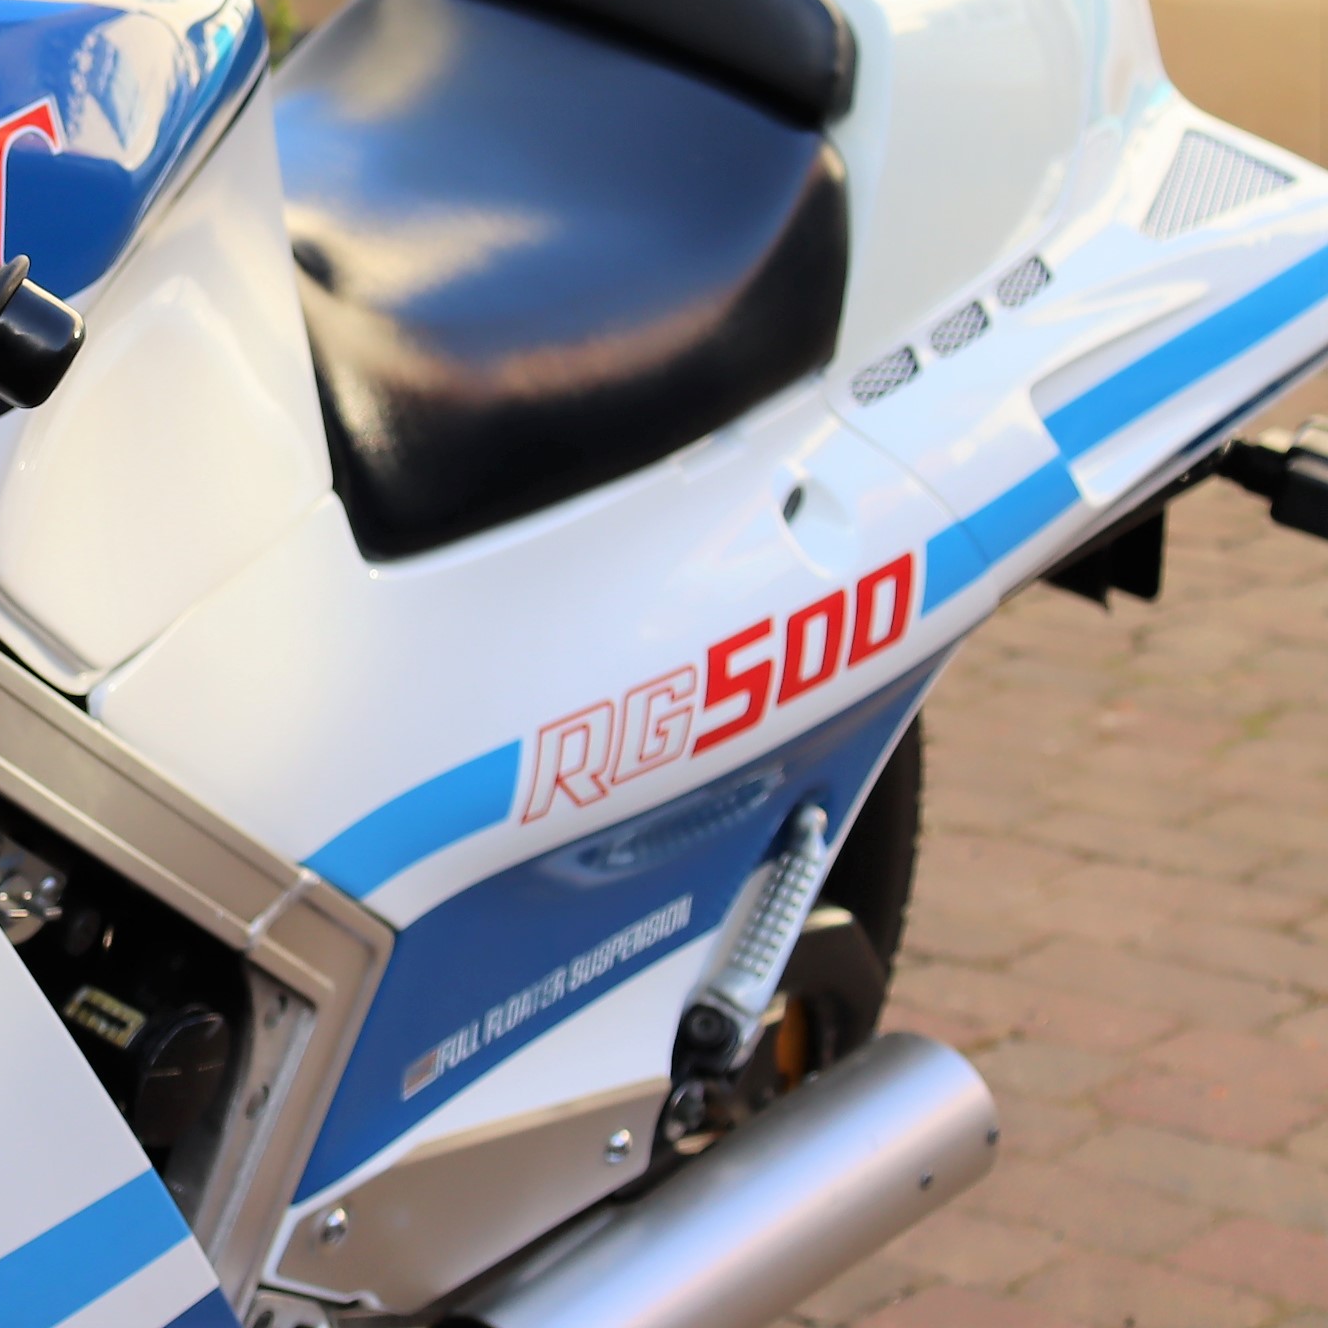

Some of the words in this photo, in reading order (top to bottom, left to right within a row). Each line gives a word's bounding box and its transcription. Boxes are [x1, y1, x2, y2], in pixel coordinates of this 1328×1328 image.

[521, 552, 915, 825] RG500
[439, 1020, 481, 1071] FULL
[483, 965, 567, 1045] FLOATER
[569, 893, 693, 991] SUSPENSION
